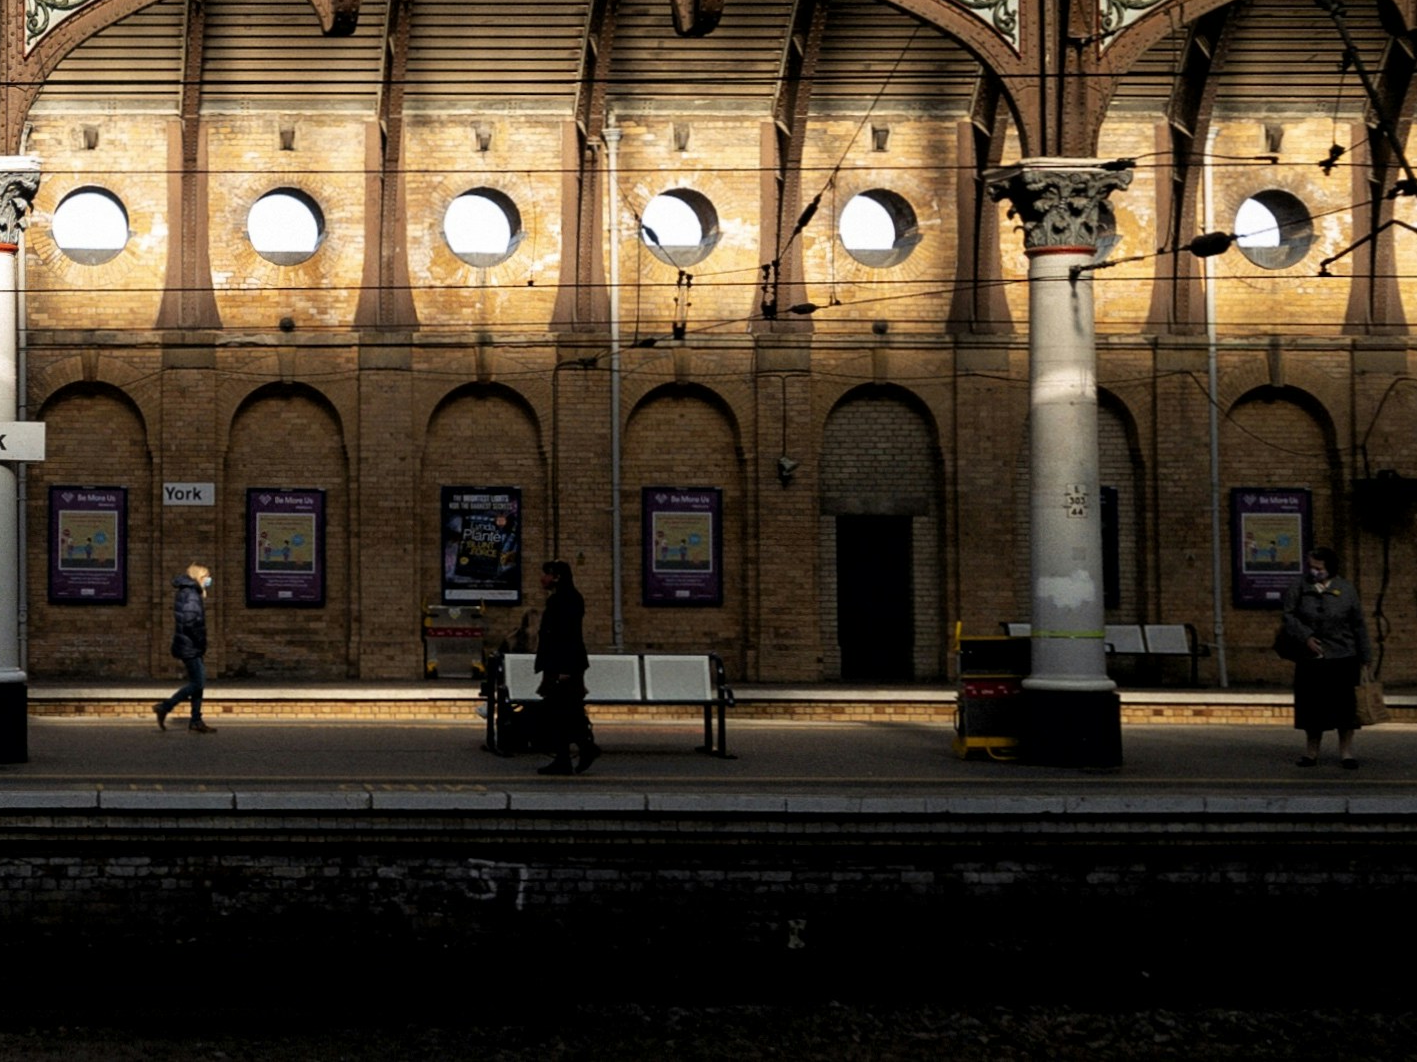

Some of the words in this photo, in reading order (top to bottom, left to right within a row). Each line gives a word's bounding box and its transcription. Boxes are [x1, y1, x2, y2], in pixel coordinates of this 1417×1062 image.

[164, 486, 202, 500] York
[77, 494, 86, 502] Be
[87, 494, 106, 502] More
[107, 494, 116, 502] Us
[274, 496, 284, 504] Be
[285, 496, 303, 504] More
[304, 496, 314, 505] Us
[670, 495, 680, 503] Be
[681, 495, 699, 503] More
[1069, 496, 1086, 505] 303
[1071, 508, 1083, 516] 44
